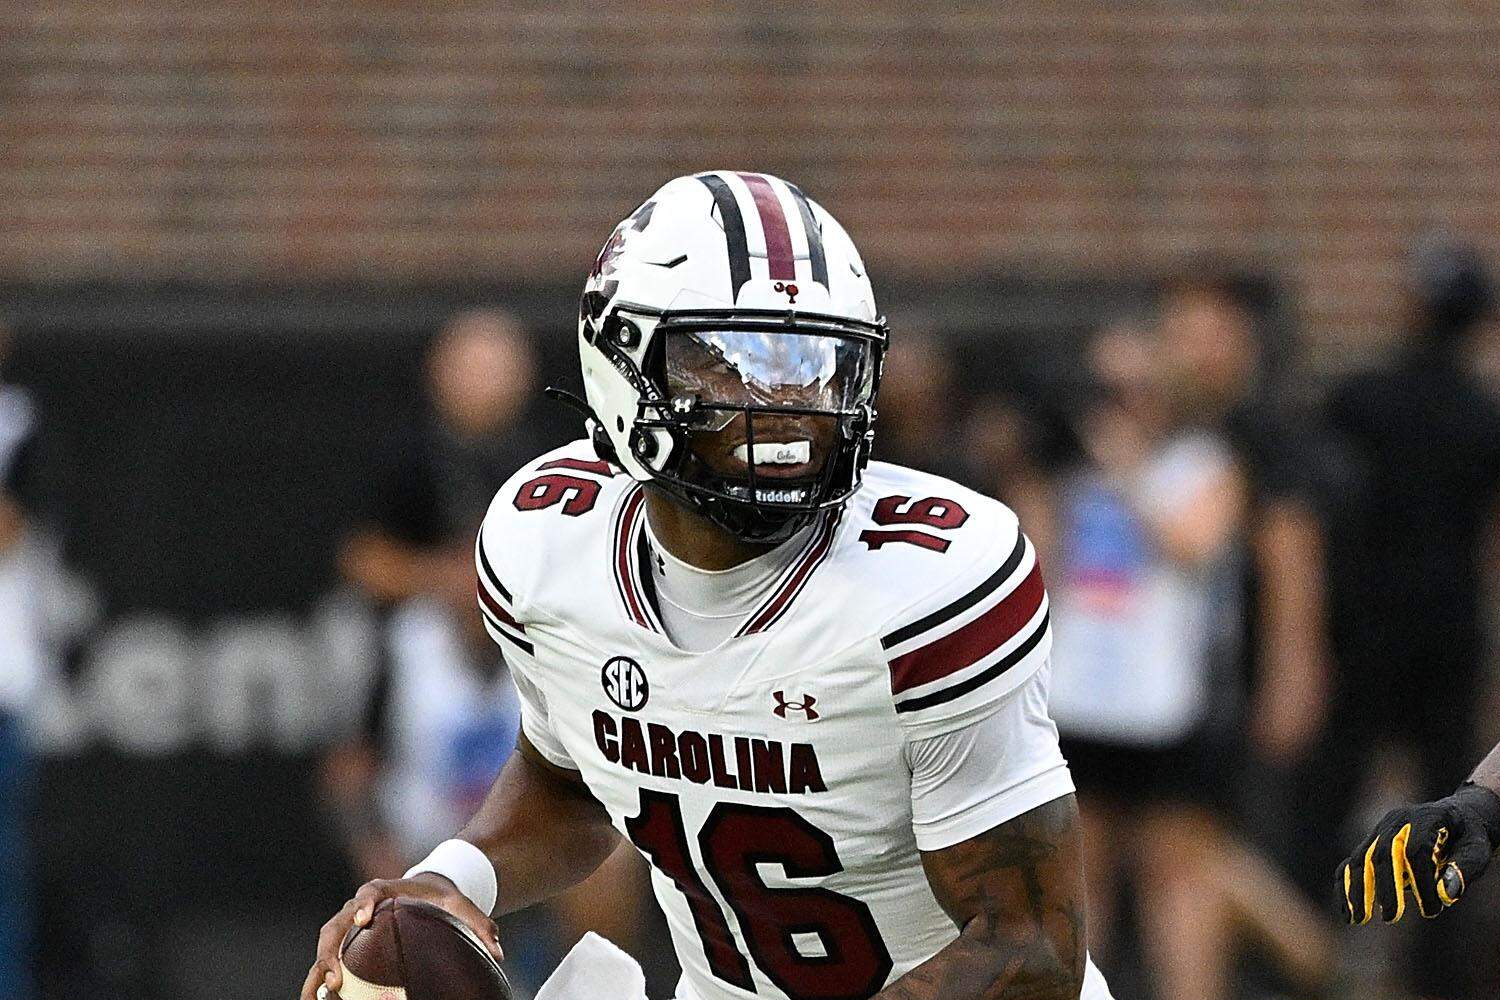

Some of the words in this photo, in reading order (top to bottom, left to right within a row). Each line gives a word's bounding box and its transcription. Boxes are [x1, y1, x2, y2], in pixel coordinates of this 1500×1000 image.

[512, 457, 616, 517] 16
[858, 495, 970, 554] 16
[605, 659, 645, 708] SEC
[592, 708, 829, 794] CAROLINA
